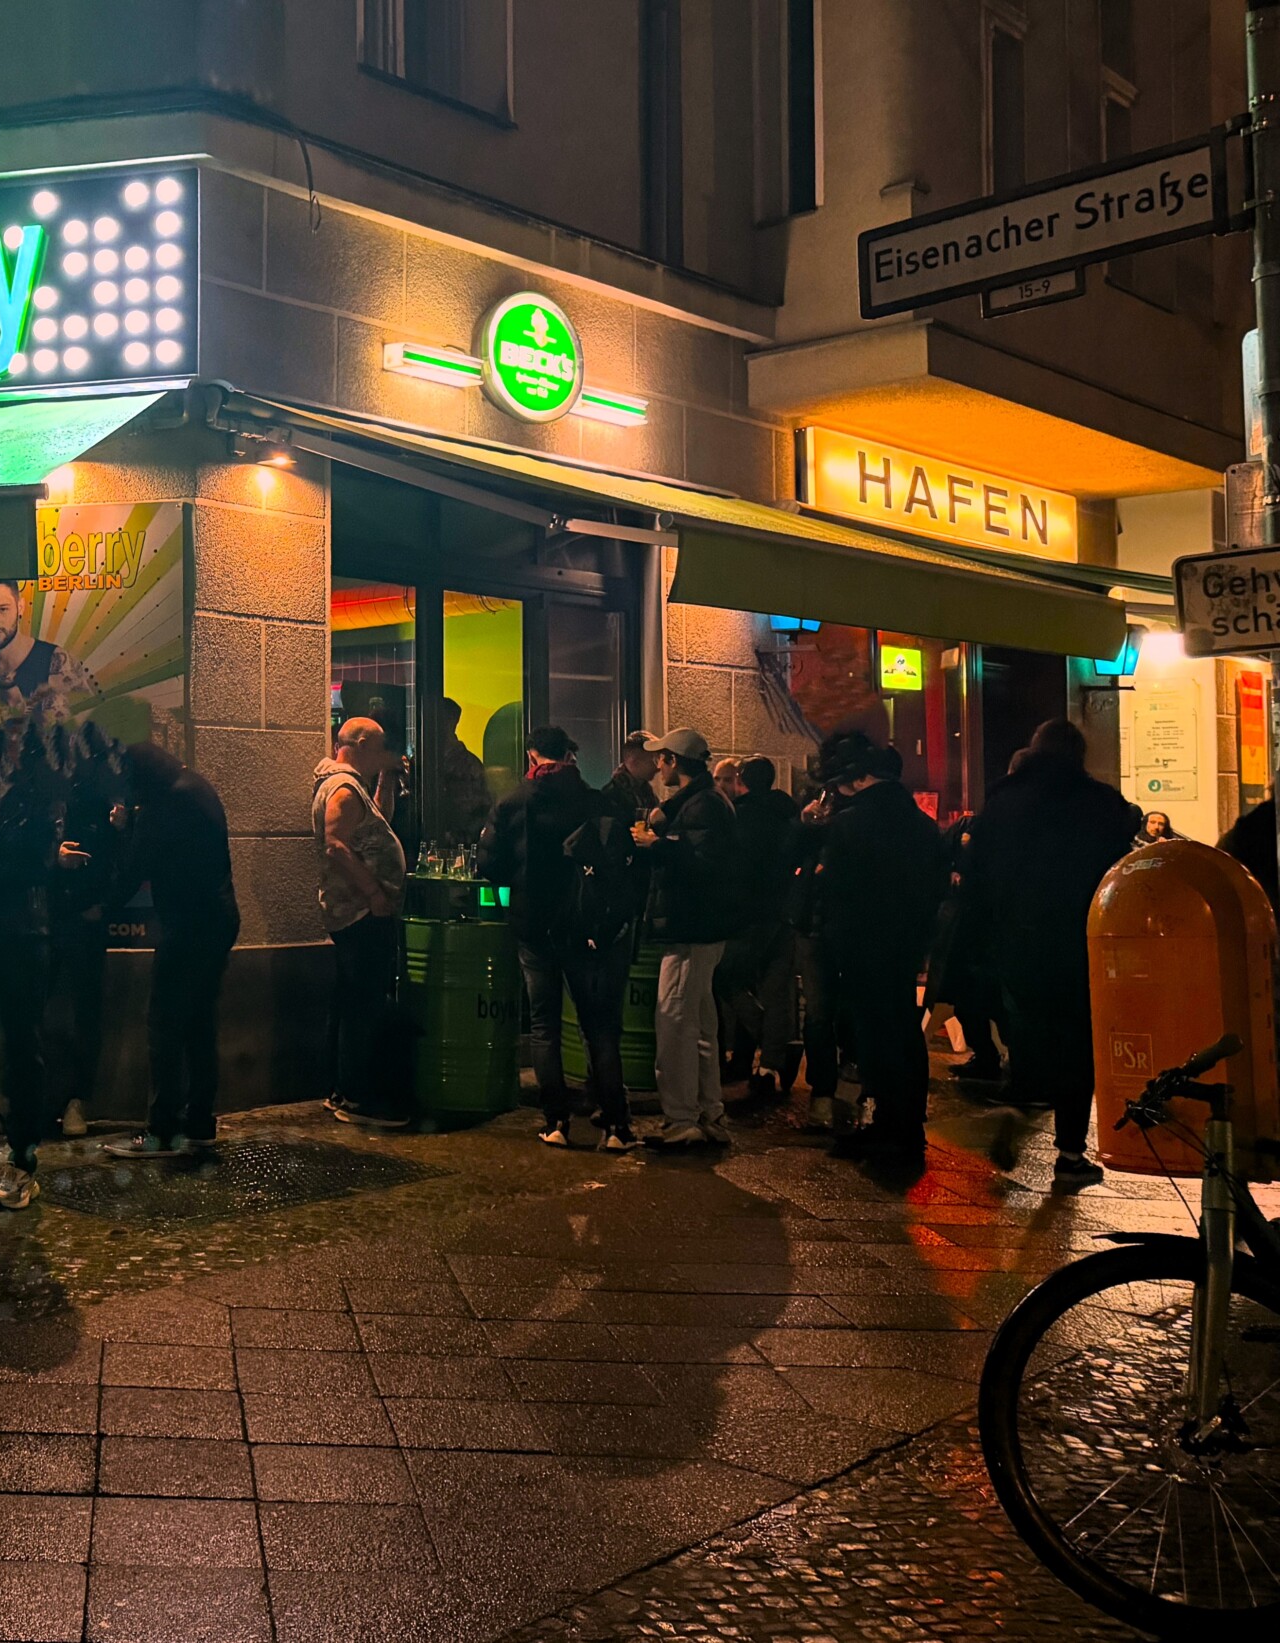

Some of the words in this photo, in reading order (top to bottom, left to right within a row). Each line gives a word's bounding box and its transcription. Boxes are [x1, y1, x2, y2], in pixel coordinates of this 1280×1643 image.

[874, 212, 1060, 283] Eisenacher
[1074, 171, 1210, 231] Straße
[1018, 280, 1051, 299] 15-9
[858, 450, 1048, 545] HAFEN
[37, 520, 147, 589] berry
[38, 574, 122, 592] BERLIN
[1114, 1040, 1148, 1069] BSR
